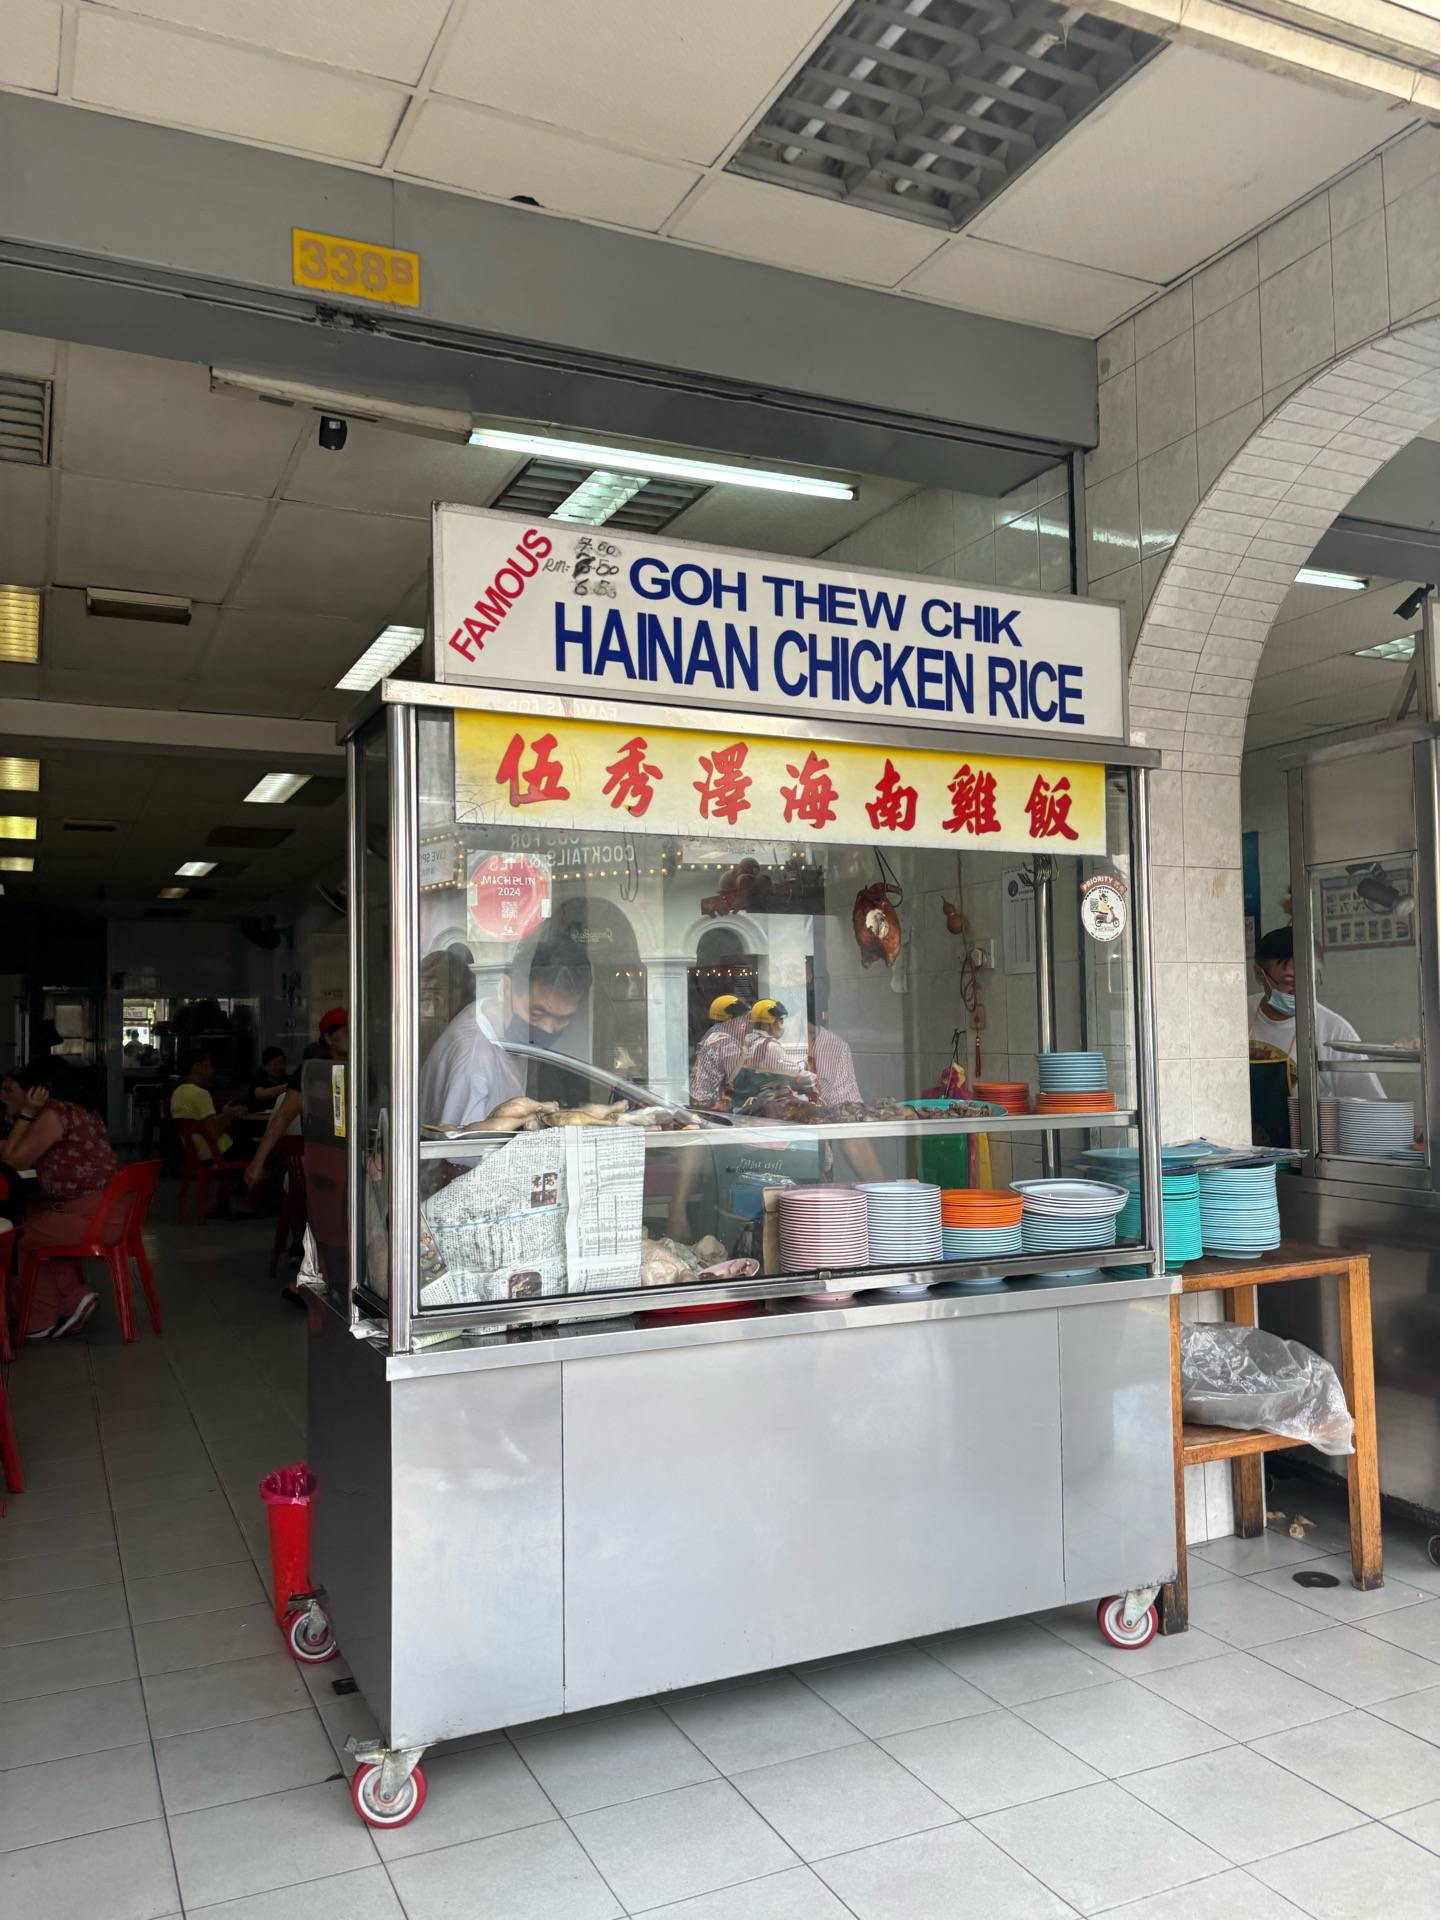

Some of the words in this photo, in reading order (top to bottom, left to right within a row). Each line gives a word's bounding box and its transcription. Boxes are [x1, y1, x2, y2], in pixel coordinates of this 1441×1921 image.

[300, 238, 415, 293] 338B
[449, 529, 553, 662] FAMOUS
[630, 558, 747, 612] GOH
[764, 576, 906, 631] THEW
[922, 599, 1021, 646] CHIK
[556, 602, 759, 692] HAINAN
[774, 631, 974, 714] CHICKEN
[989, 656, 1085, 725] RICE
[482, 875, 536, 887] MICHELIN
[497, 887, 521, 897] 2024
[1082, 875, 1113, 891] PRIORITY
